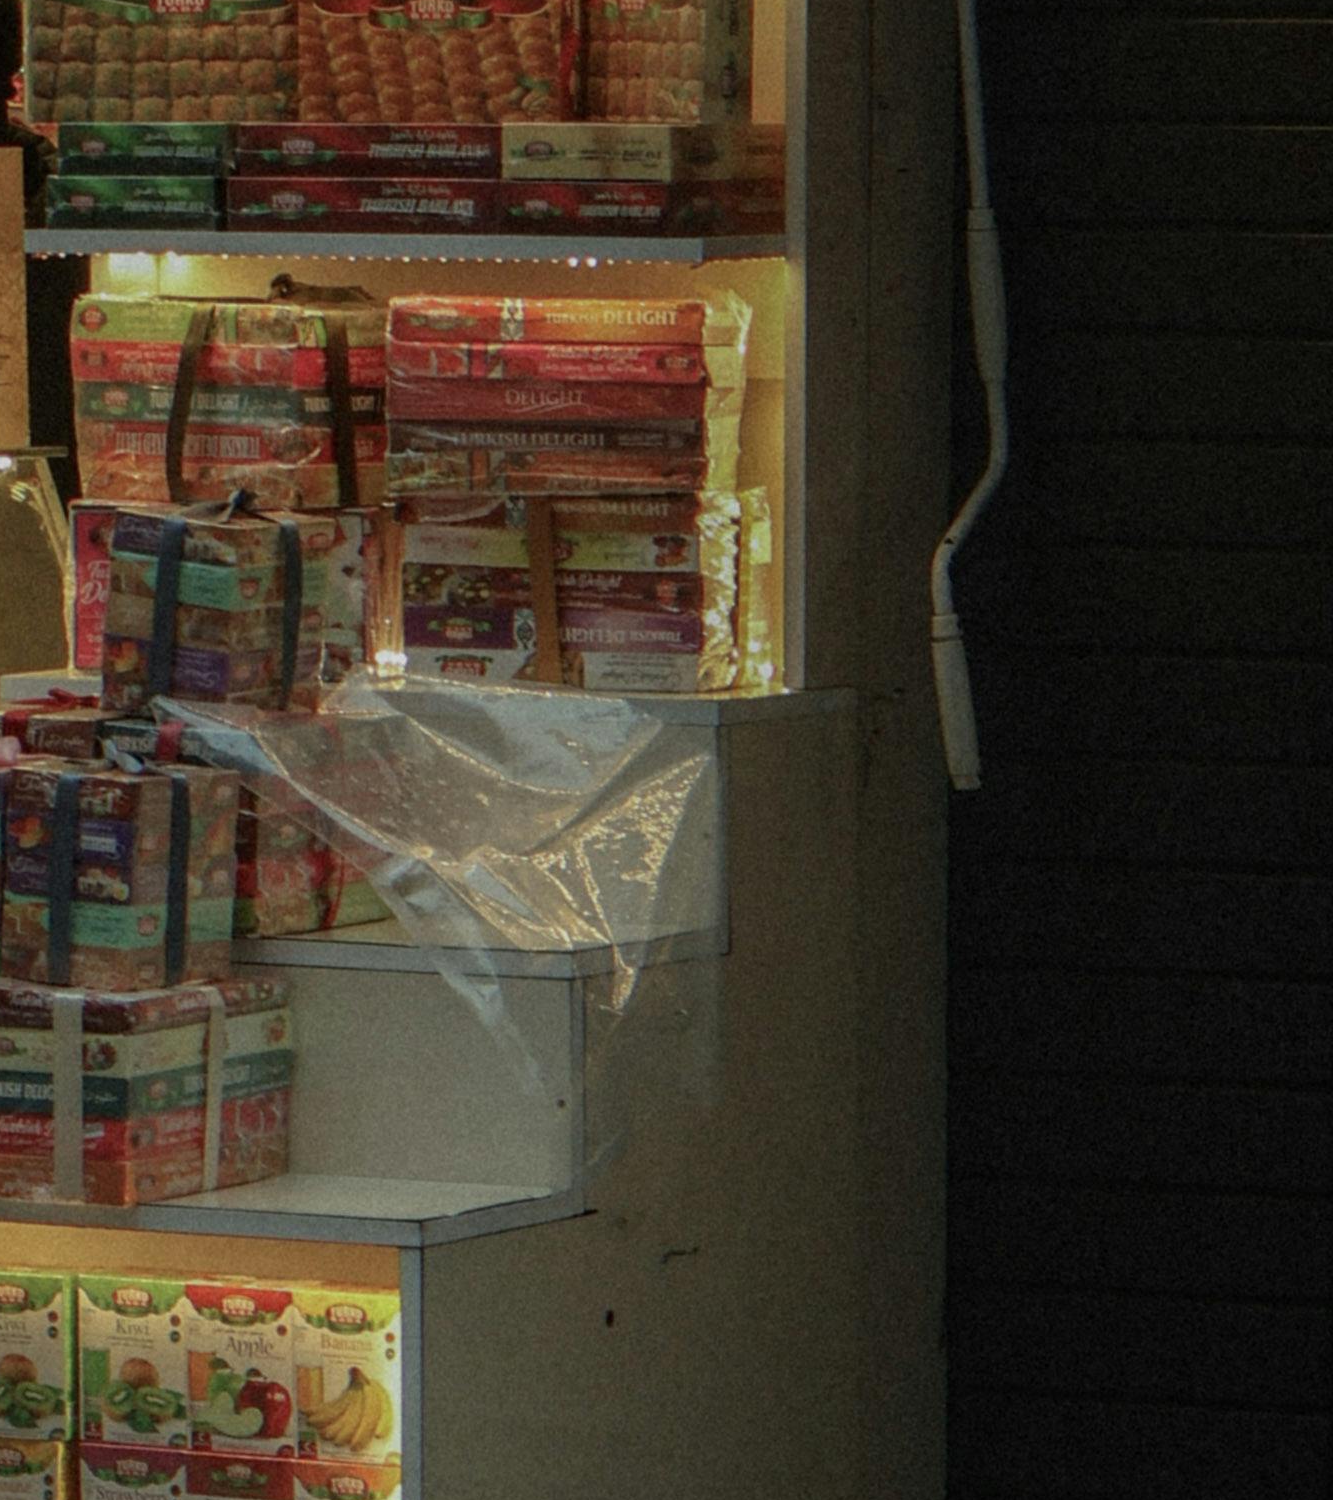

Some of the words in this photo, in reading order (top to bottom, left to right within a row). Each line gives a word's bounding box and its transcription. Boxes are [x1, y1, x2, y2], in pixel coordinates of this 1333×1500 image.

[602, 309, 678, 326] DELIGHT
[114, 1318, 151, 1335] Kiwi
[225, 1335, 276, 1358] Apple
